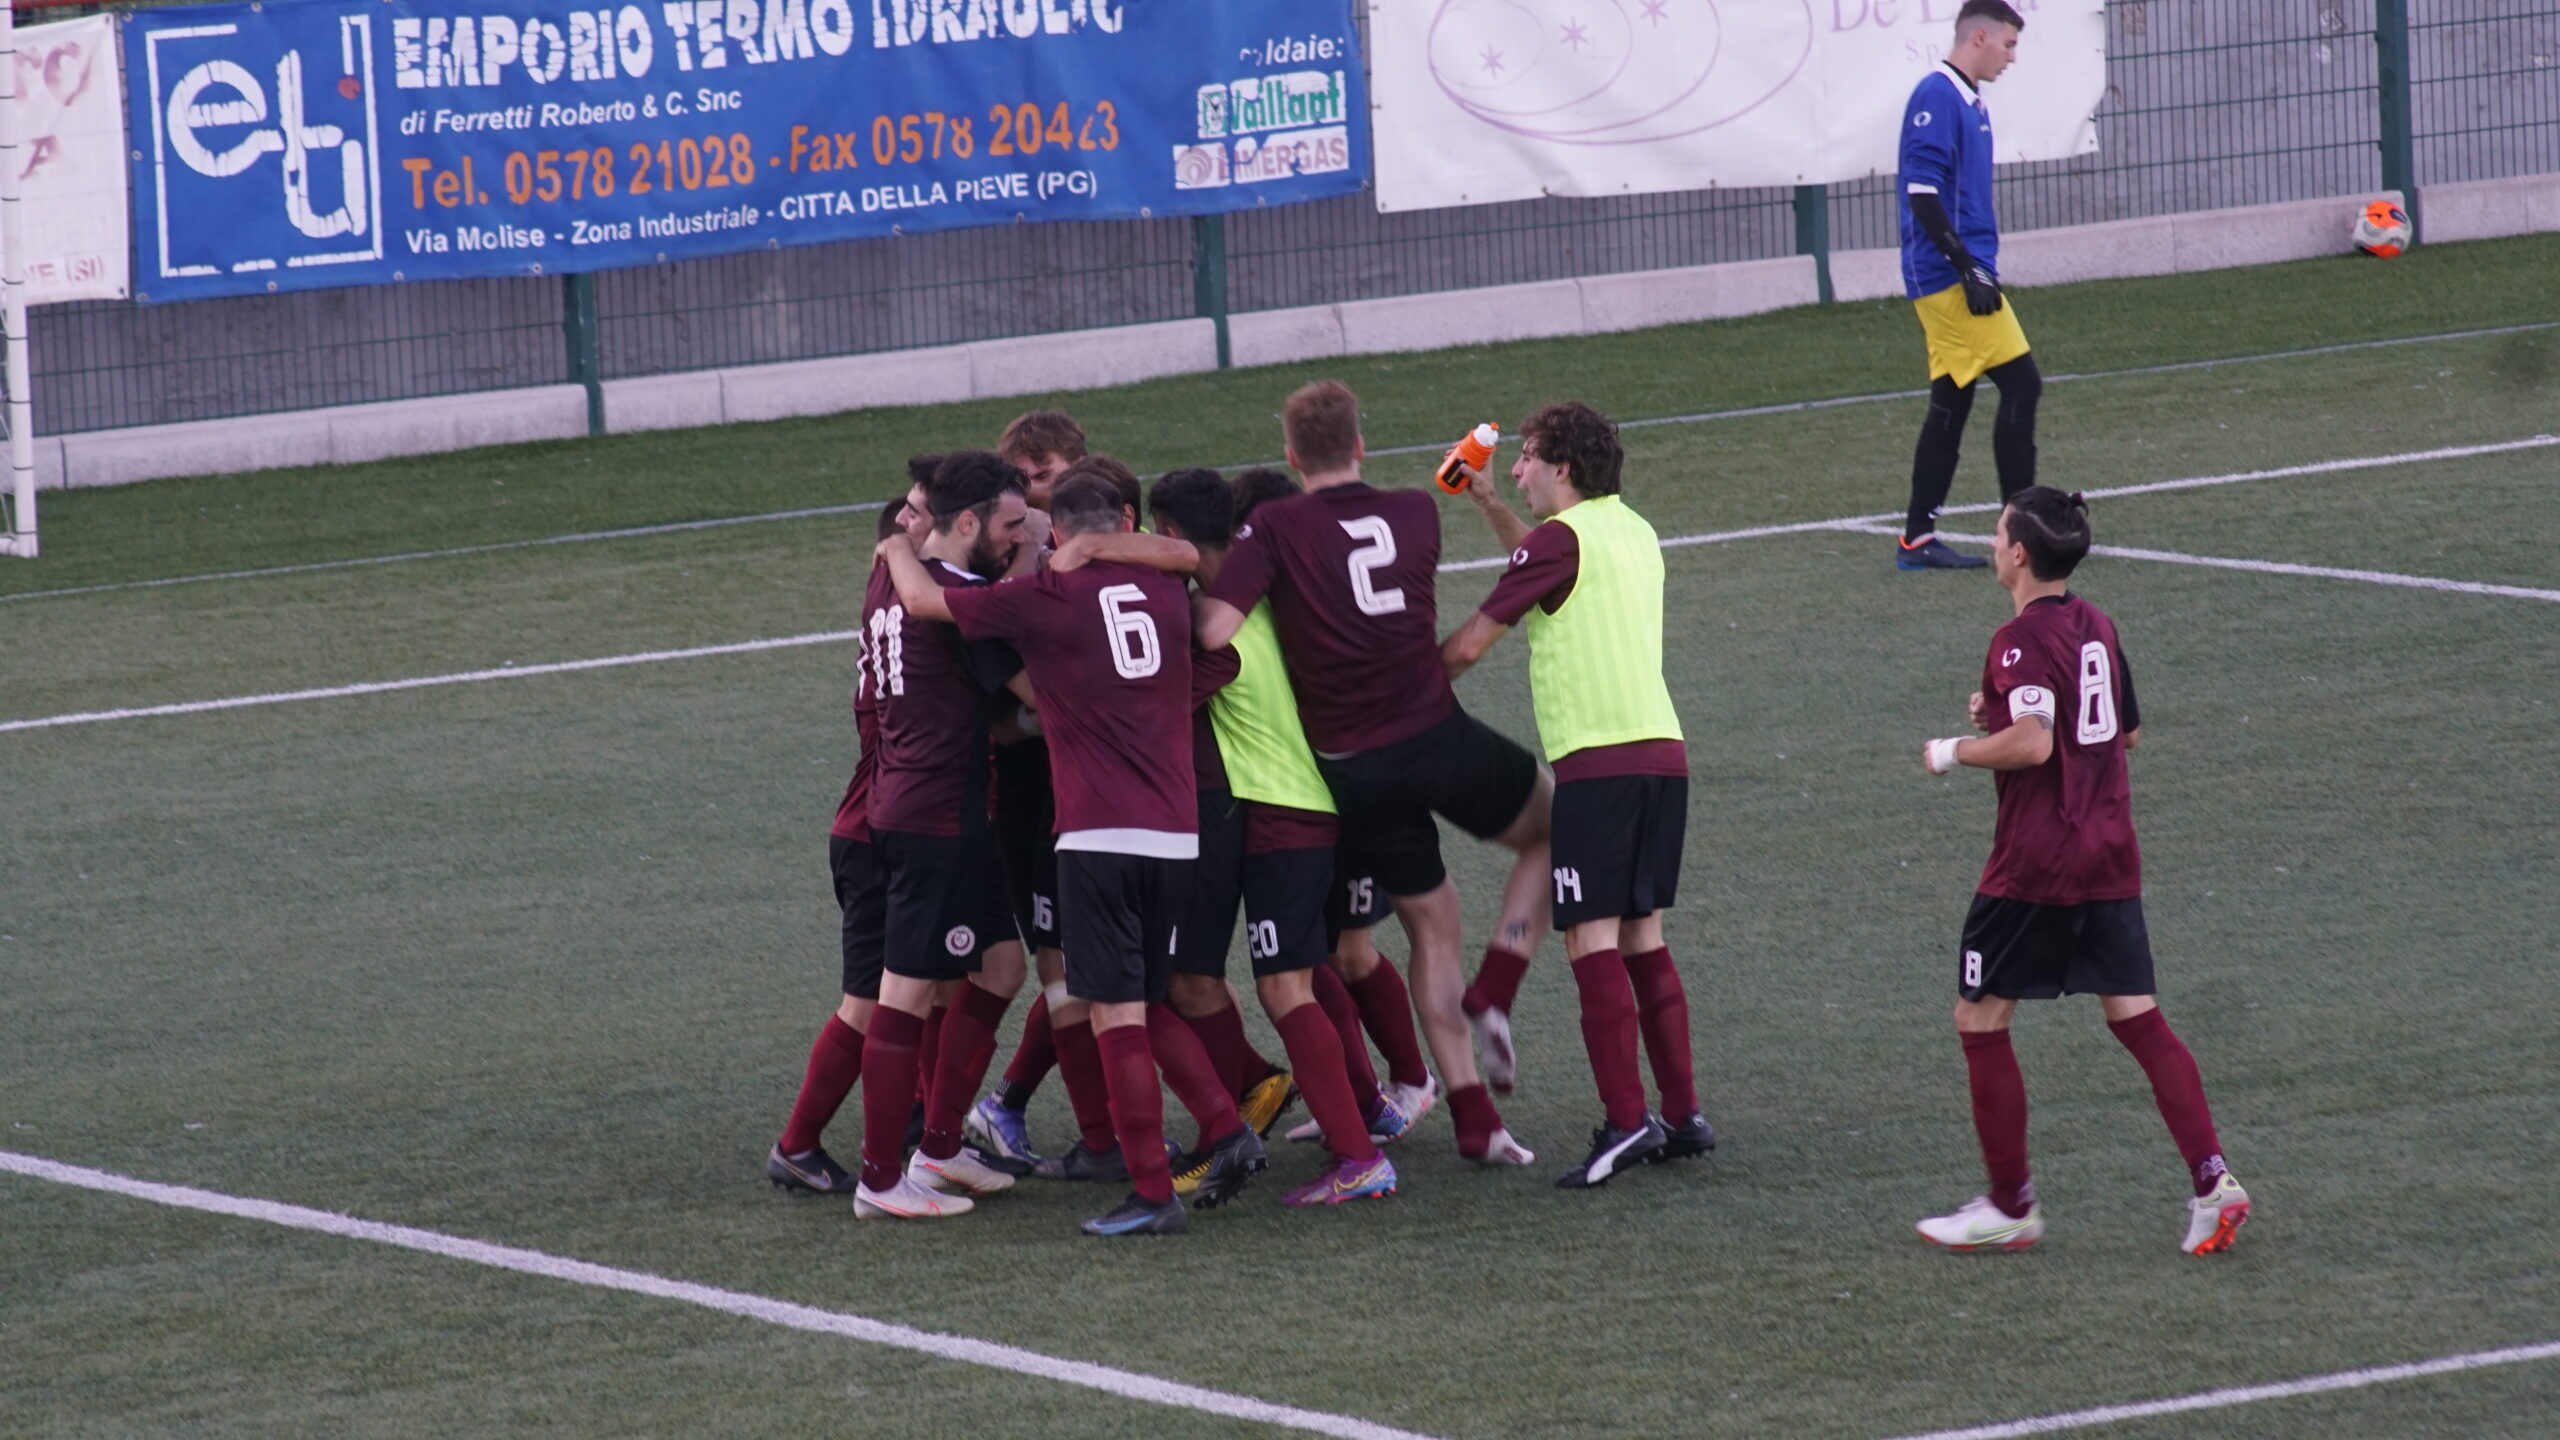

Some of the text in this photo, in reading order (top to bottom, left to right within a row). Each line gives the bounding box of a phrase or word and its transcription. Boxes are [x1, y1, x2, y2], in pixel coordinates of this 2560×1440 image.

[393, 4, 653, 88] EMPORIO
[663, 0, 854, 71] TERMO
[399, 88, 743, 136] di Ferretti Roberto & C. Snc
[1231, 73, 1341, 131] Vaillant
[401, 155, 489, 210] Tel.
[504, 146, 616, 205] 0578
[628, 132, 756, 195] 21028
[789, 124, 859, 174] Fax
[871, 111, 975, 166] 0578
[405, 228, 449, 254] Via
[457, 223, 546, 253] Molise
[571, 218, 632, 246] Zona
[639, 203, 760, 239] Industriale
[780, 190, 857, 221] CITTA
[861, 181, 948, 213] DELLA
[955, 173, 1029, 203] PIEVE
[1036, 169, 1098, 201] (PG)
[1337, 514, 1407, 617] 2
[1098, 582, 1162, 680] 6
[2077, 640, 2119, 747] 8
[1346, 876, 1374, 916] 15
[1552, 866, 1584, 905] 14
[1248, 918, 1280, 960] 20
[1964, 949, 1982, 989] 8
